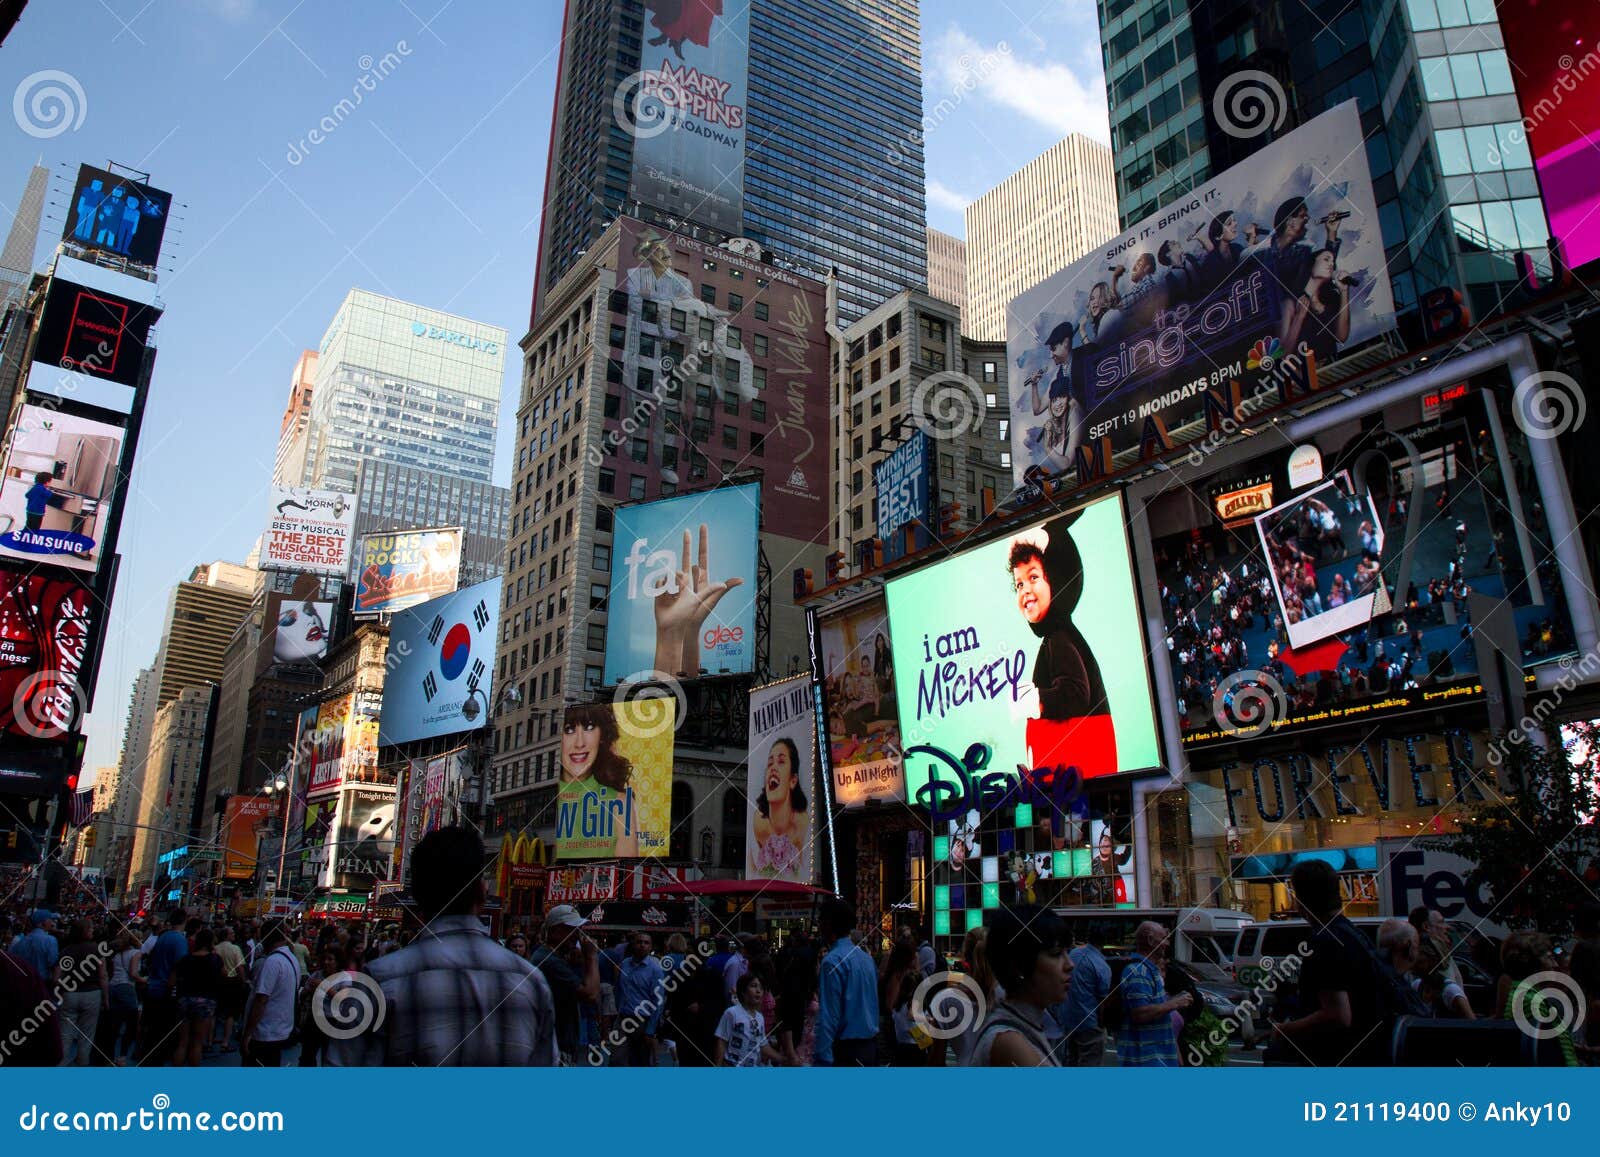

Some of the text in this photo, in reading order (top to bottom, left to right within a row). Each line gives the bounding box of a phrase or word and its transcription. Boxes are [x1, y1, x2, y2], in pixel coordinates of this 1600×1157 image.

[661, 58, 732, 101] MARY
[642, 70, 744, 129] POPPINS
[671, 114, 739, 149] BROADWAY
[1106, 235, 1136, 261] SING
[1158, 203, 1200, 231] BRING
[704, 246, 762, 274] Colombian
[763, 266, 800, 288] Coffee
[1095, 270, 1263, 387] sing-off
[1152, 303, 1191, 332] the
[428, 324, 498, 356] BARCLAYS
[1089, 361, 1243, 441] SEPT 19 MONDAYS 8PM
[879, 466, 922, 526] BEST
[272, 521, 347, 537] BEST MUSICAL
[878, 500, 923, 541] MUSICAL
[12, 530, 84, 553] SAMSUNG
[268, 541, 344, 558] MUSICAL OF
[268, 550, 291, 560] THIS
[306, 534, 346, 549] BEST
[367, 534, 421, 552] NUNS
[704, 624, 744, 650] glee
[935, 625, 980, 659] am
[753, 697, 788, 737] MAMMA
[1271, 719, 1292, 728] Heels
[1292, 716, 1306, 724] are
[1307, 711, 1329, 721] made
[1330, 708, 1342, 718] for
[1344, 704, 1371, 717] power
[1372, 697, 1410, 710] walking.
[1424, 685, 1473, 701] Everything
[1211, 730, 1219, 738] in
[1220, 728, 1236, 739] your
[837, 764, 898, 787] Up All Night
[1221, 727, 1487, 828] FOREVER
[358, 791, 381, 801] Tonight
[582, 787, 633, 838] Girl
